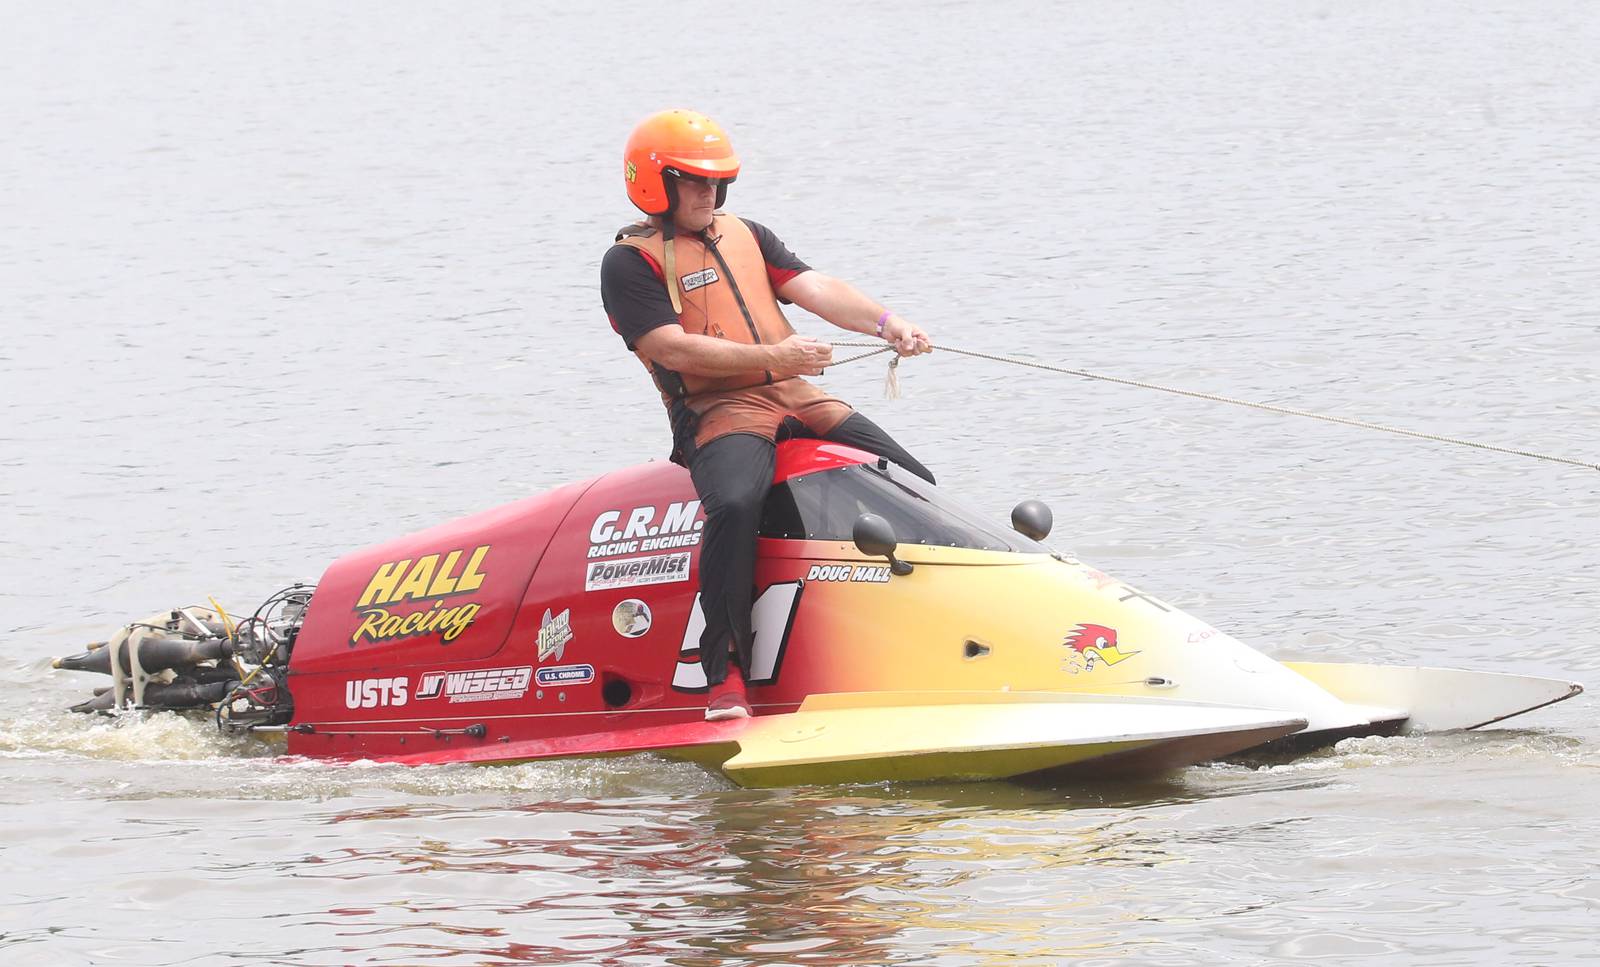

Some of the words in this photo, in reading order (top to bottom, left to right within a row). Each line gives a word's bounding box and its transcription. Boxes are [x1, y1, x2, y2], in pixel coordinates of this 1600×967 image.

[589, 499, 704, 544] G.R.M.
[586, 540, 639, 559] RACING
[640, 531, 702, 553] ENGINES
[354, 545, 490, 608] HALL
[590, 554, 688, 582] PowerMist
[806, 564, 852, 582] DOUG
[851, 566, 891, 583] HALL
[351, 599, 482, 644] Racing
[544, 672, 558, 681] U.S.
[558, 670, 586, 680] CHROME
[345, 676, 409, 710] USTS
